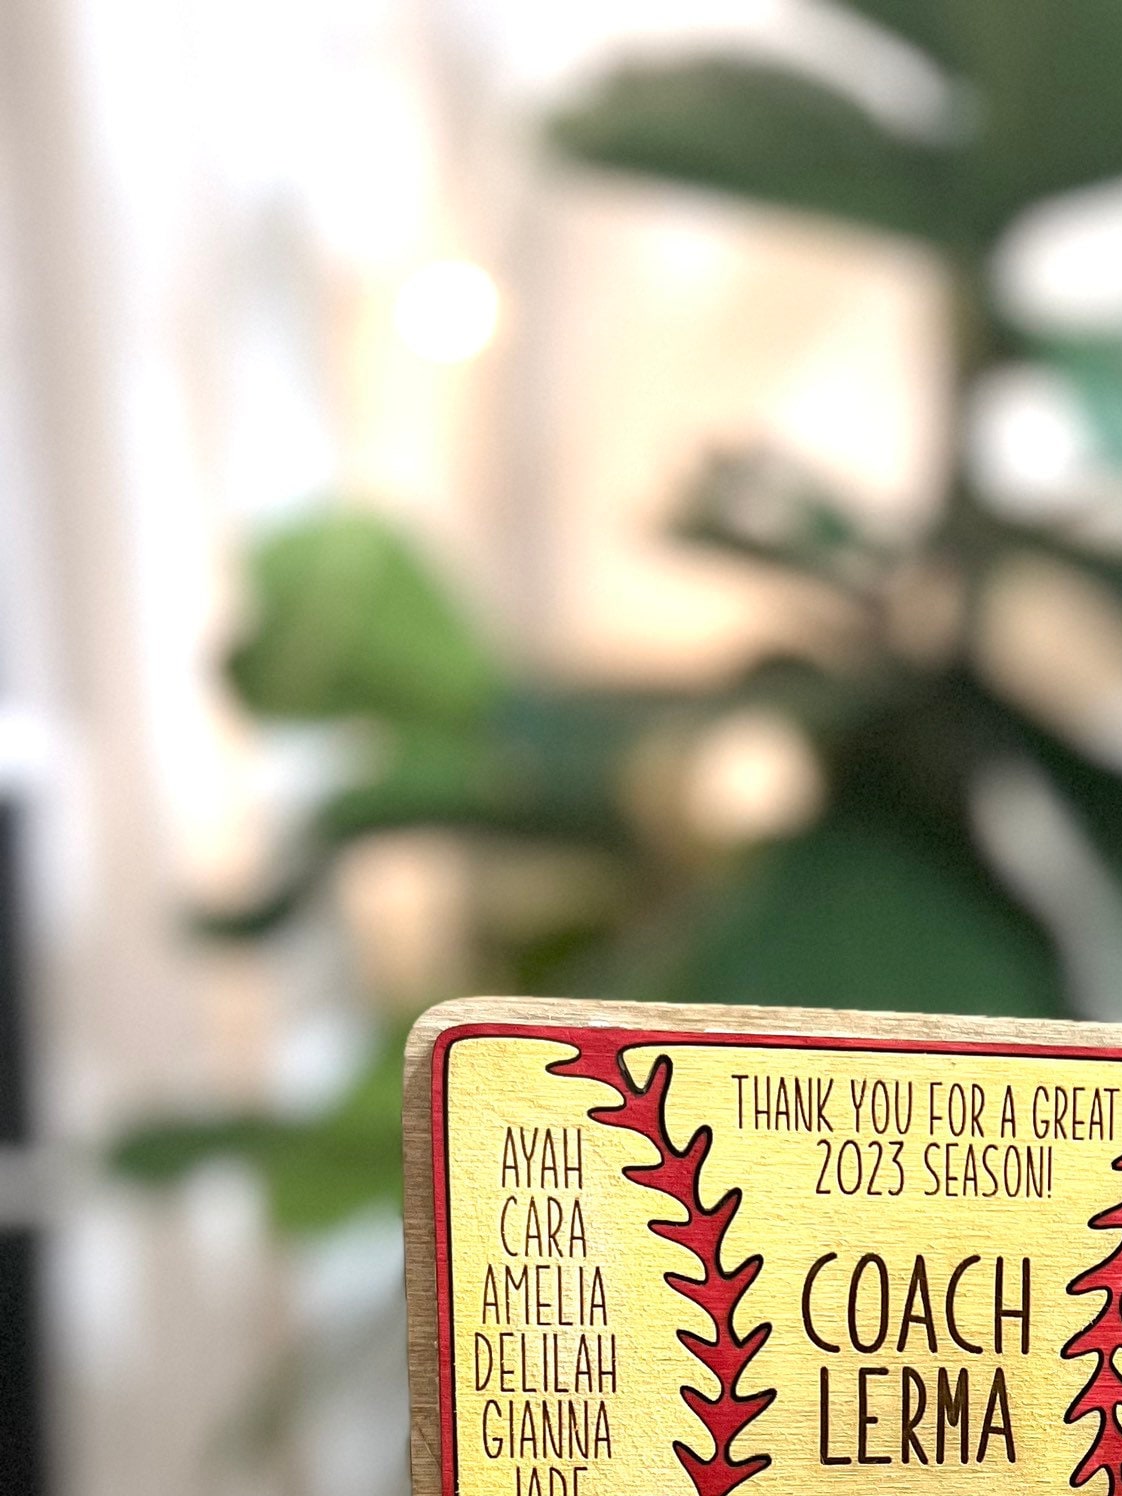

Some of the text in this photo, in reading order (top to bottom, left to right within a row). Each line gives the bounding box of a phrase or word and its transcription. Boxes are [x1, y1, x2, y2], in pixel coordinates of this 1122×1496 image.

[731, 1074, 1120, 1140] THANK YOU FOR A GREAT
[501, 1126, 583, 1190] AYAH
[815, 1138, 1053, 1198] 2023 SEASON!
[500, 1195, 587, 1258] CARA
[482, 1263, 608, 1326] AMELIA
[801, 1251, 1031, 1355] COACH
[474, 1331, 617, 1393] DELILAH
[482, 1399, 612, 1459] GIANNA
[819, 1366, 1016, 1465] LERMA
